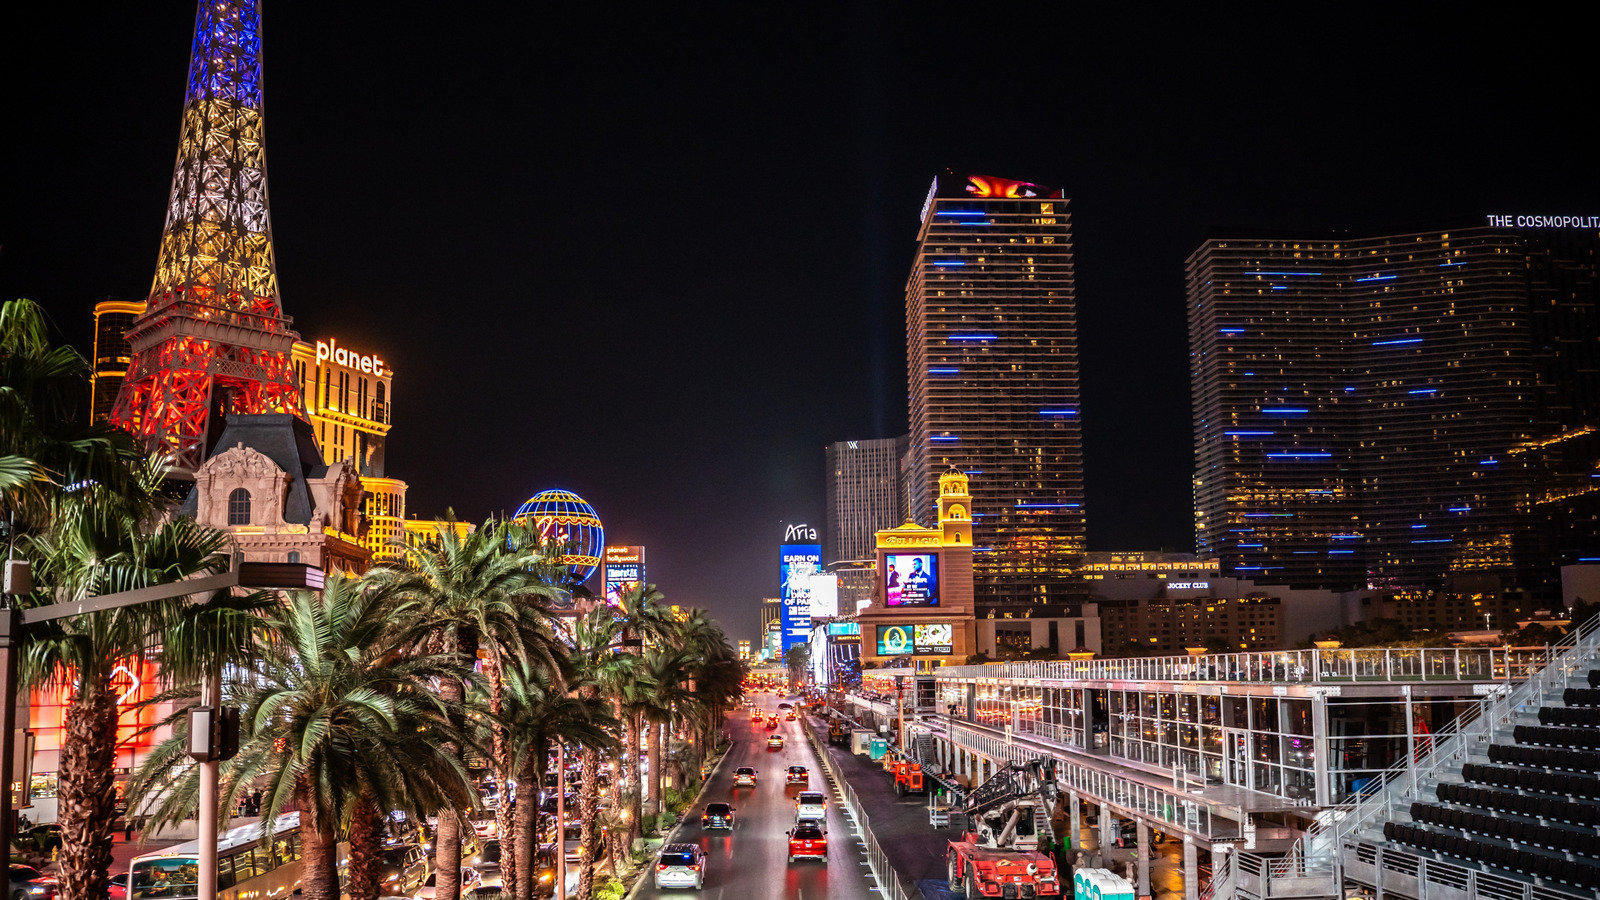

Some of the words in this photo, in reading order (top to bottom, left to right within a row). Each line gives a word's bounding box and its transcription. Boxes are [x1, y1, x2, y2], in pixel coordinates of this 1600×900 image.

[1487, 214, 1513, 227] THE
[316, 338, 384, 377] planet
[785, 524, 817, 541] Aria
[607, 555, 638, 563] hollywood
